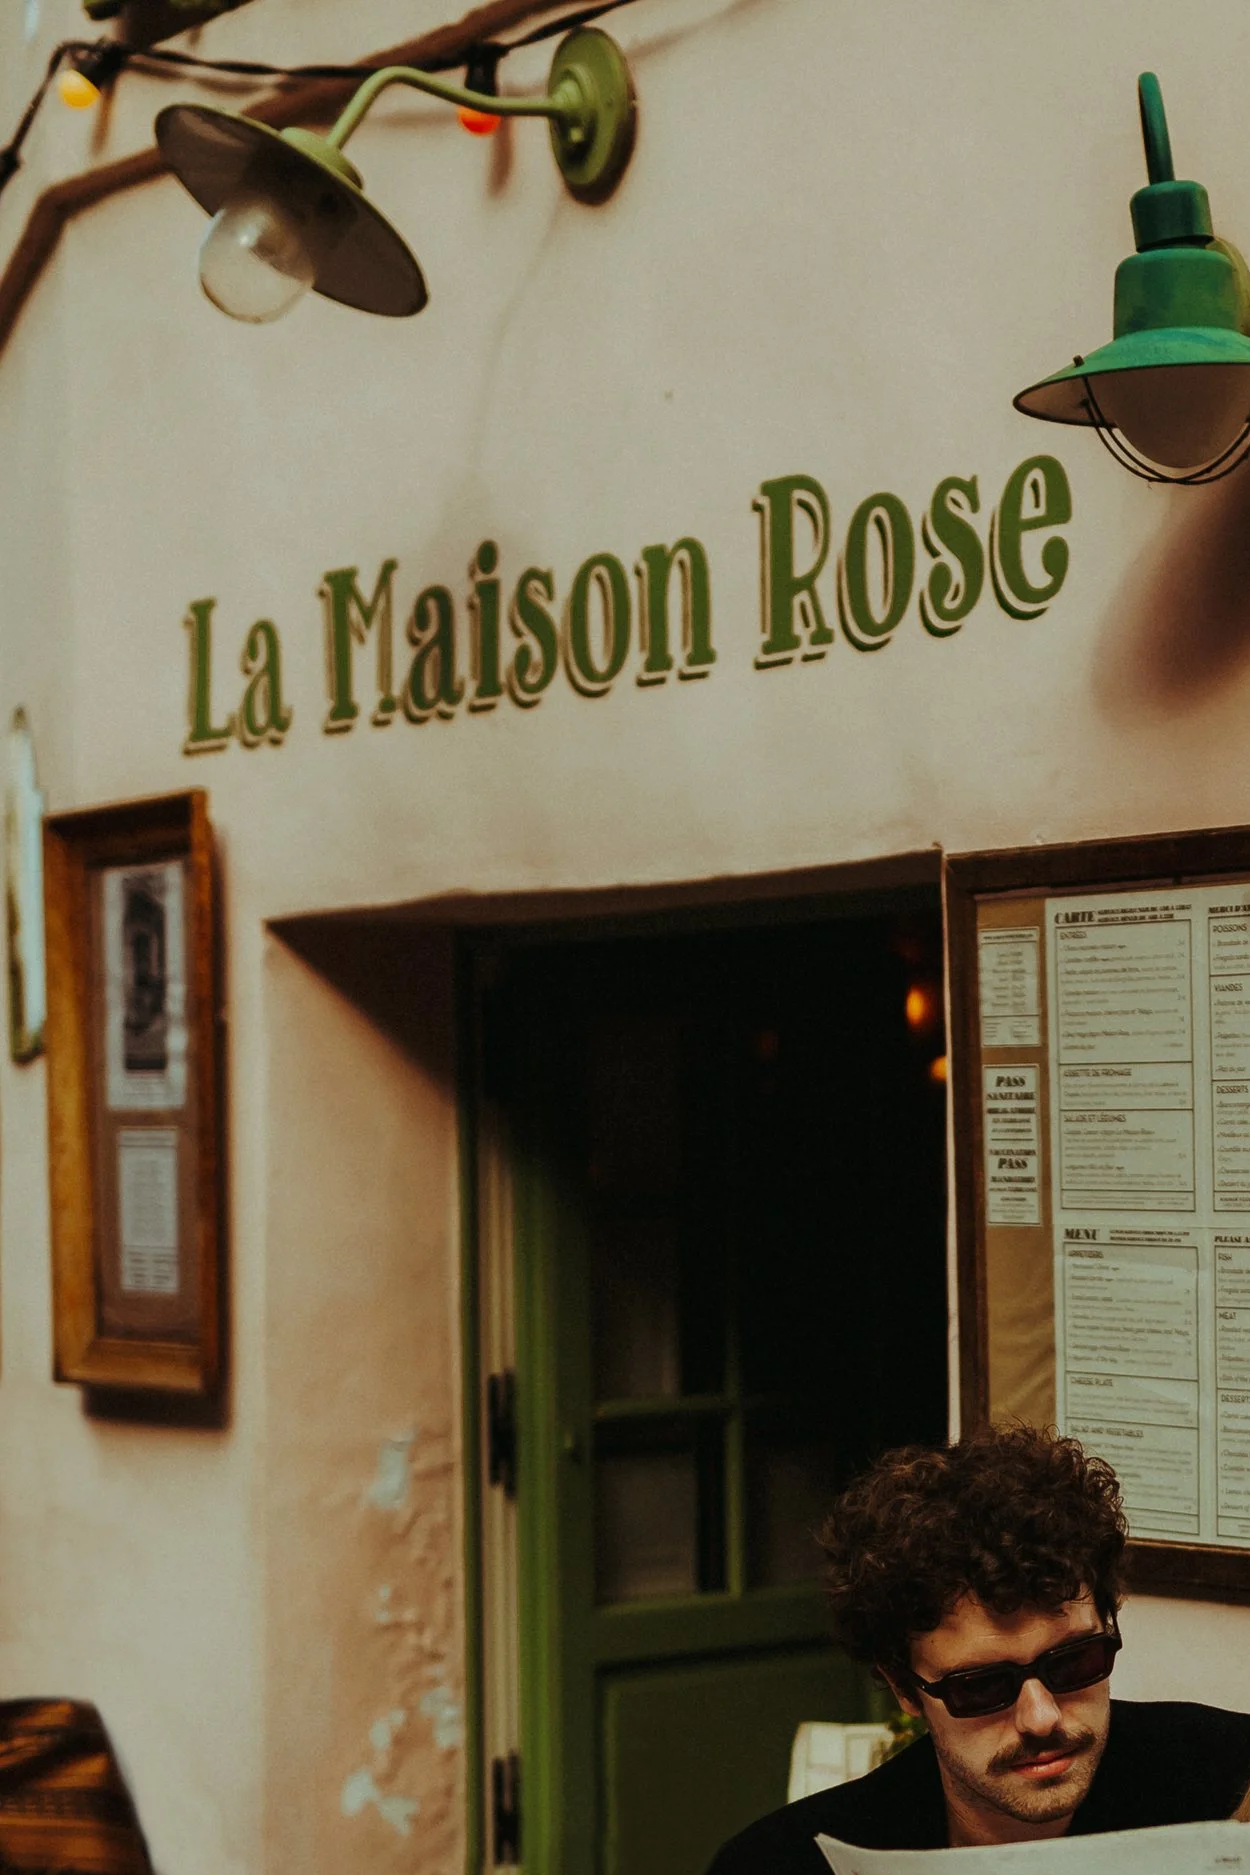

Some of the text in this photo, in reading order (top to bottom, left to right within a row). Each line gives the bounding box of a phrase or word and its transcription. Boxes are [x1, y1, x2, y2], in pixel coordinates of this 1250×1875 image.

[183, 453, 1073, 755] La Maison Rose
[1054, 910, 1095, 925] CARTE
